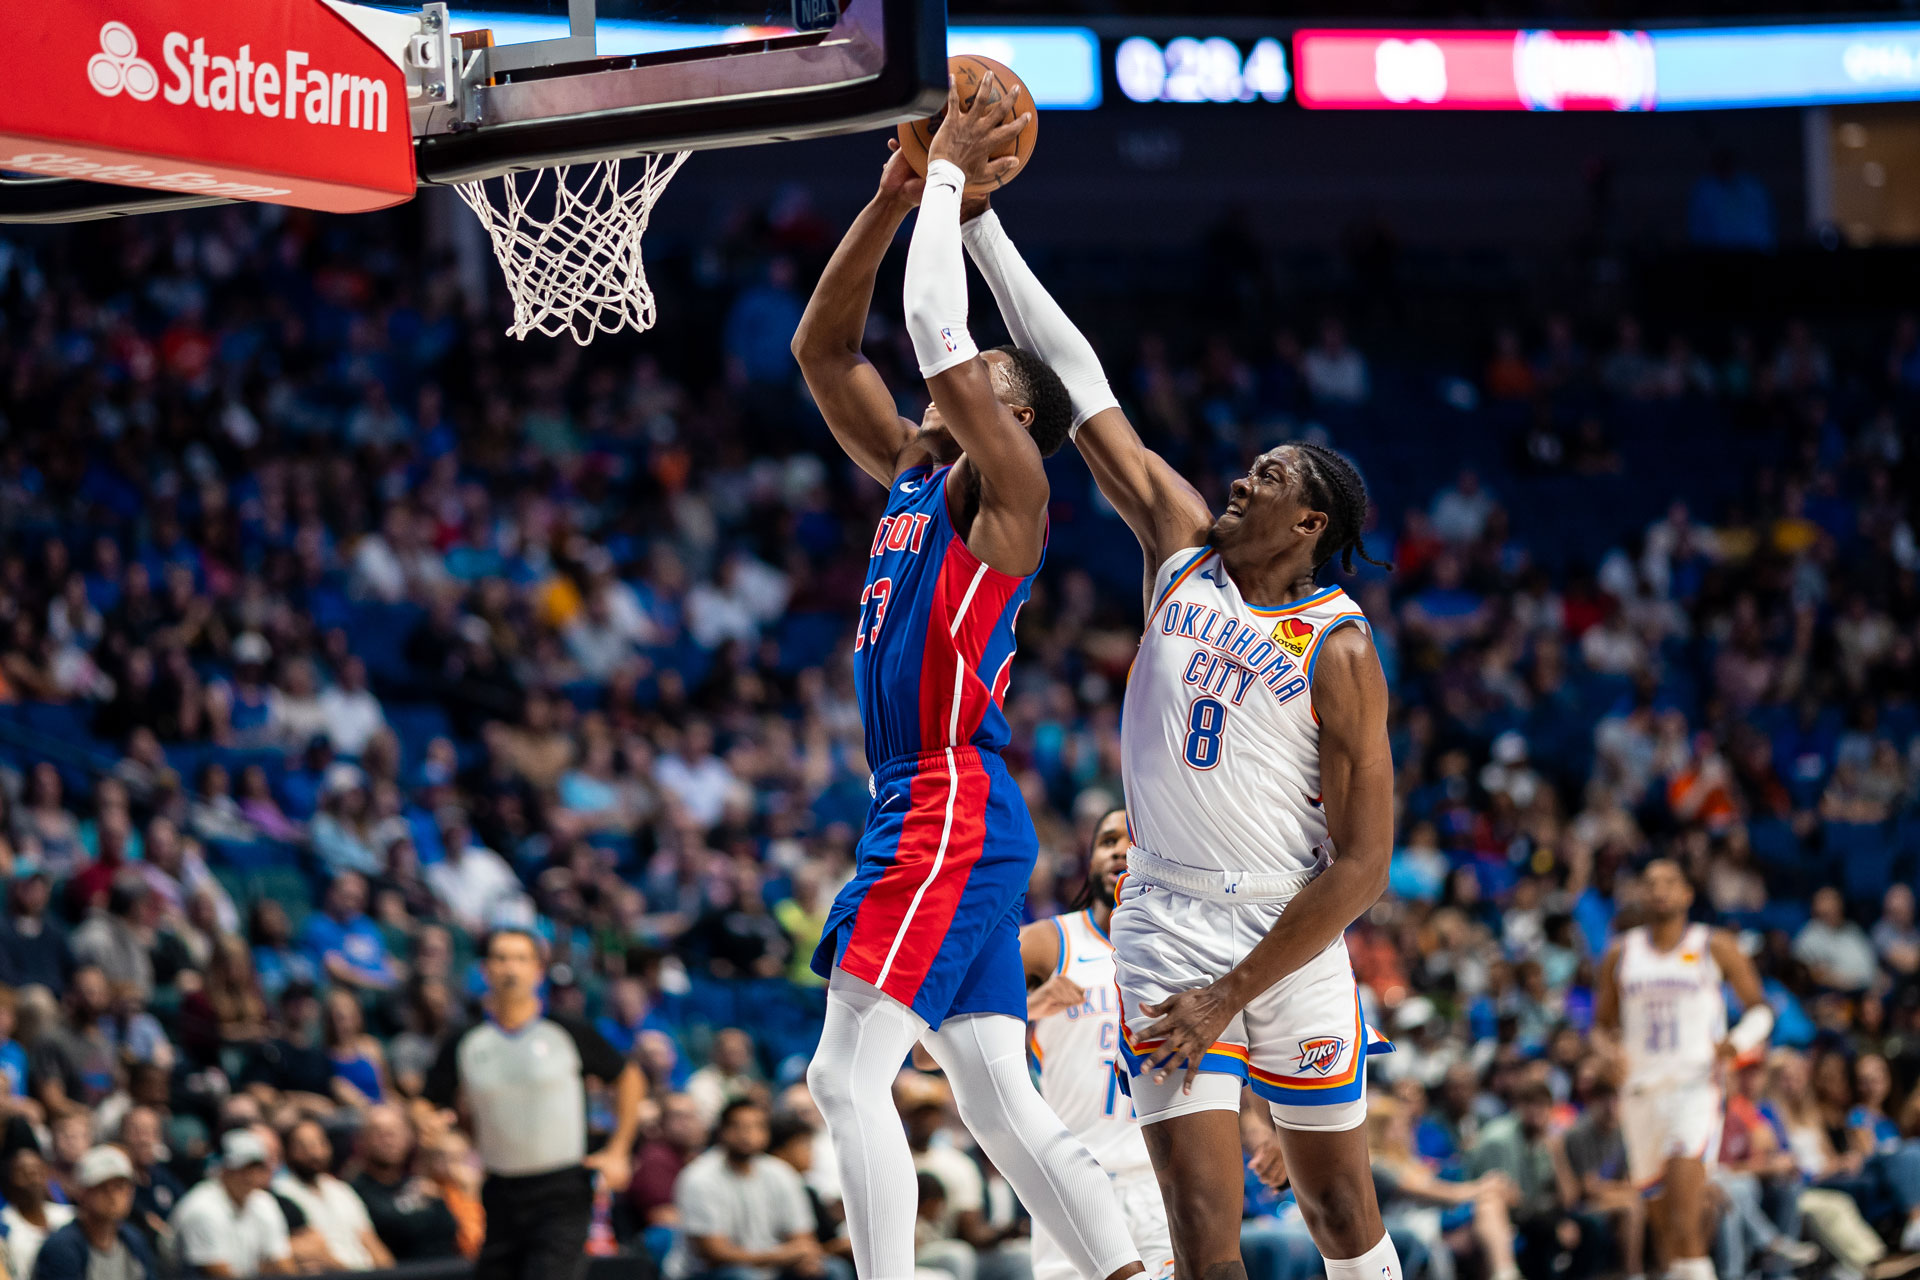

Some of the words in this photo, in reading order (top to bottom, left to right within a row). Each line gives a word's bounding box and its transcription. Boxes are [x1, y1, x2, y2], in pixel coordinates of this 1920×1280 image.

[1161, 600, 1309, 706] OKLAHOMA
[1182, 649, 1259, 706] CITY
[1182, 694, 1228, 771] 8
[1298, 1042, 1336, 1069] OKC
